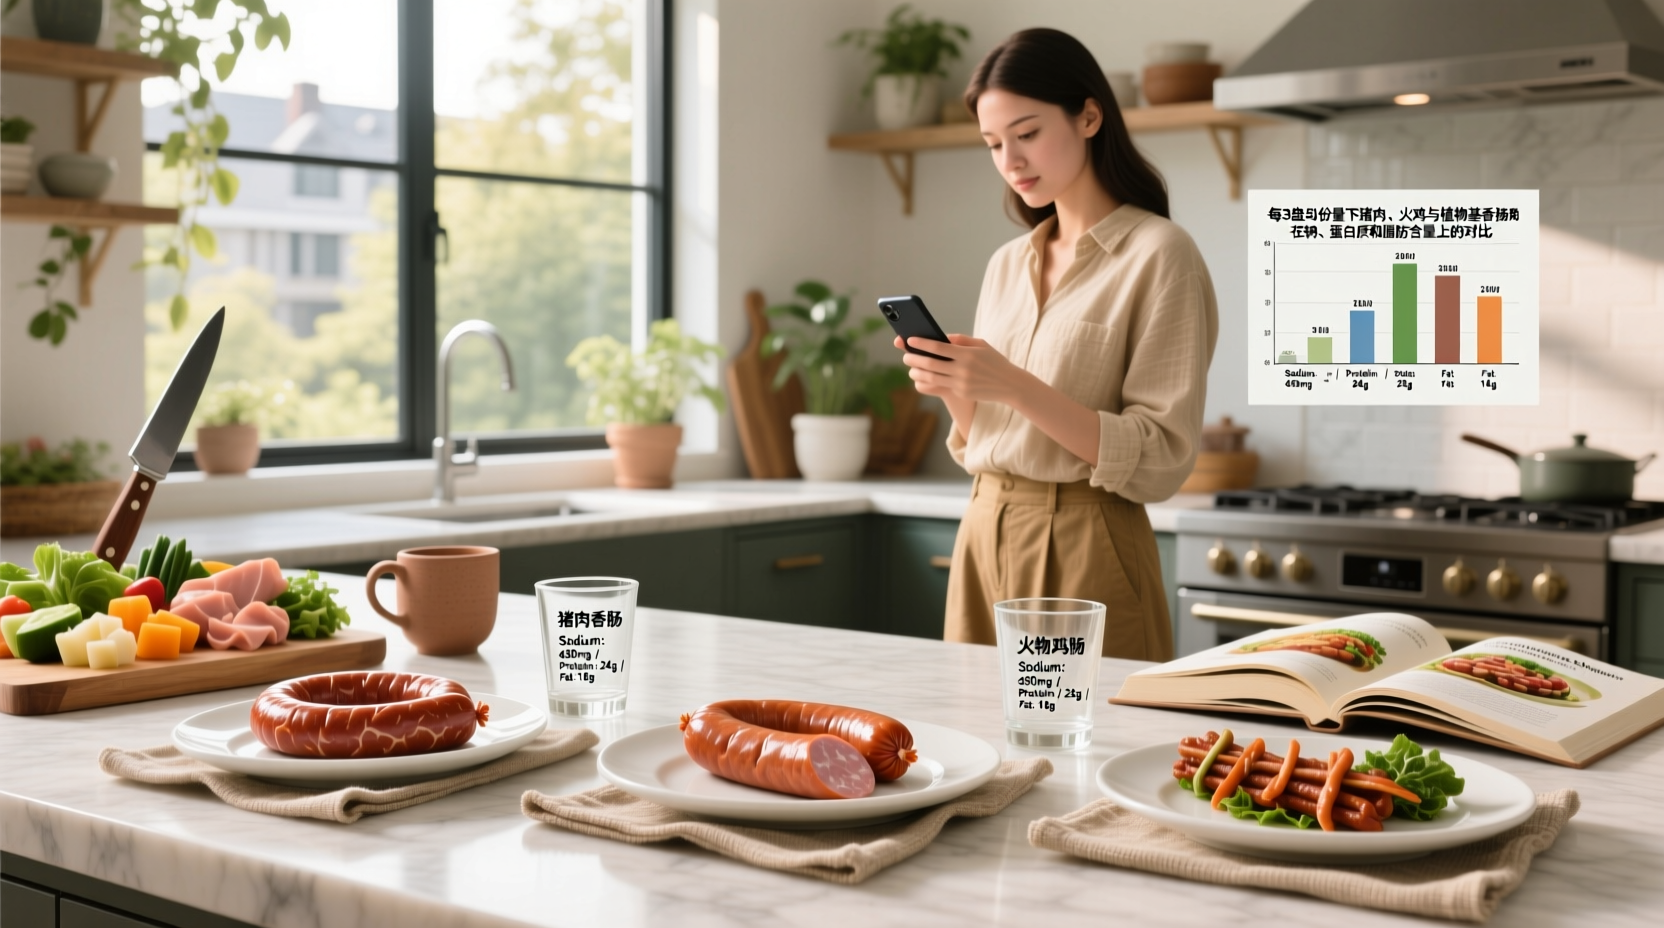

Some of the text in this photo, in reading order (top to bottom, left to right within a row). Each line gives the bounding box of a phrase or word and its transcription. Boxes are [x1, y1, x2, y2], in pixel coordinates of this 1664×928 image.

[557, 610, 623, 628] 猪肉香肠
[599, 660, 618, 673] 24g
